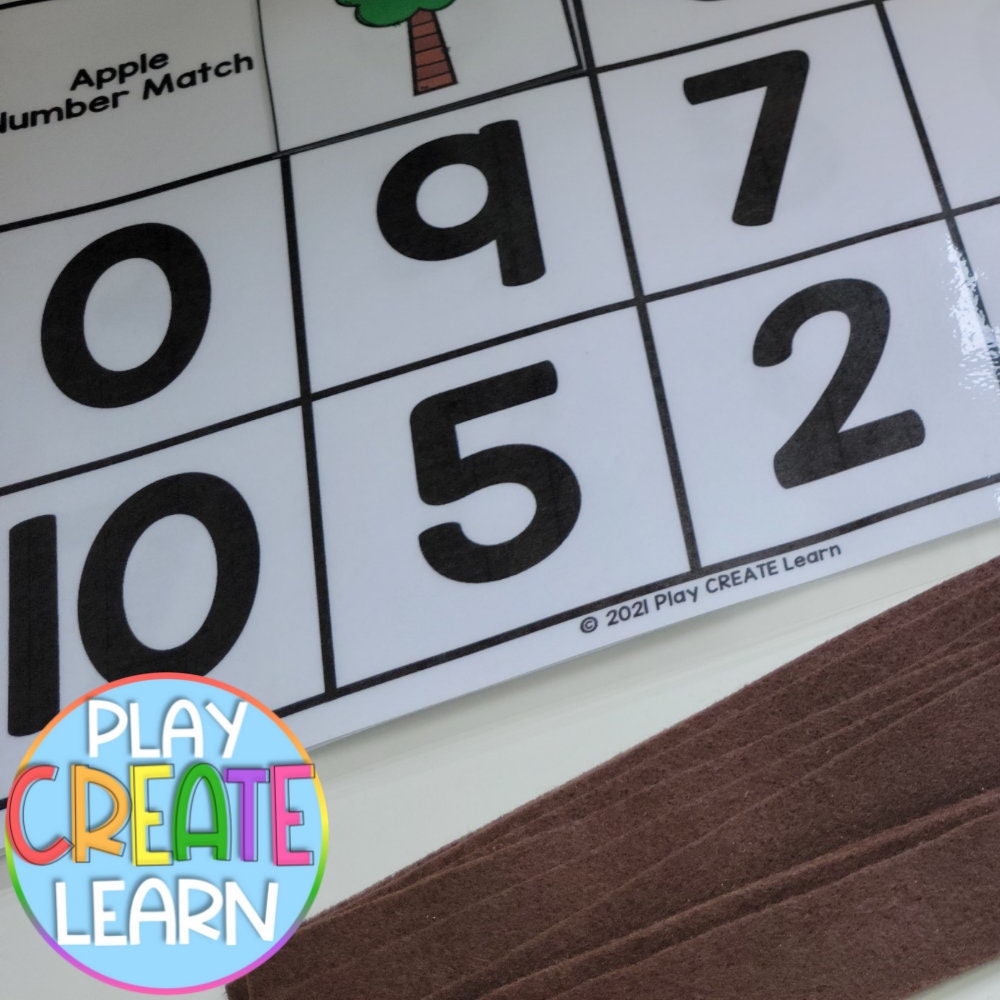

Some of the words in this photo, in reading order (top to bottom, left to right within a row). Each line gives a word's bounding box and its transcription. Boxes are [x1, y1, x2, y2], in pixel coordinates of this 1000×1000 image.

[70, 52, 169, 91] Apple
[142, 53, 254, 100] Match
[683, 50, 810, 227] 7
[376, 119, 546, 287] 9
[40, 222, 211, 409] 0
[753, 278, 926, 490] 2
[410, 360, 581, 584] 5
[7, 471, 260, 736] 10
[606, 601, 649, 627] 2021
[655, 585, 699, 611] Play
[705, 560, 779, 595] CREATE
[783, 544, 842, 572] Learn
